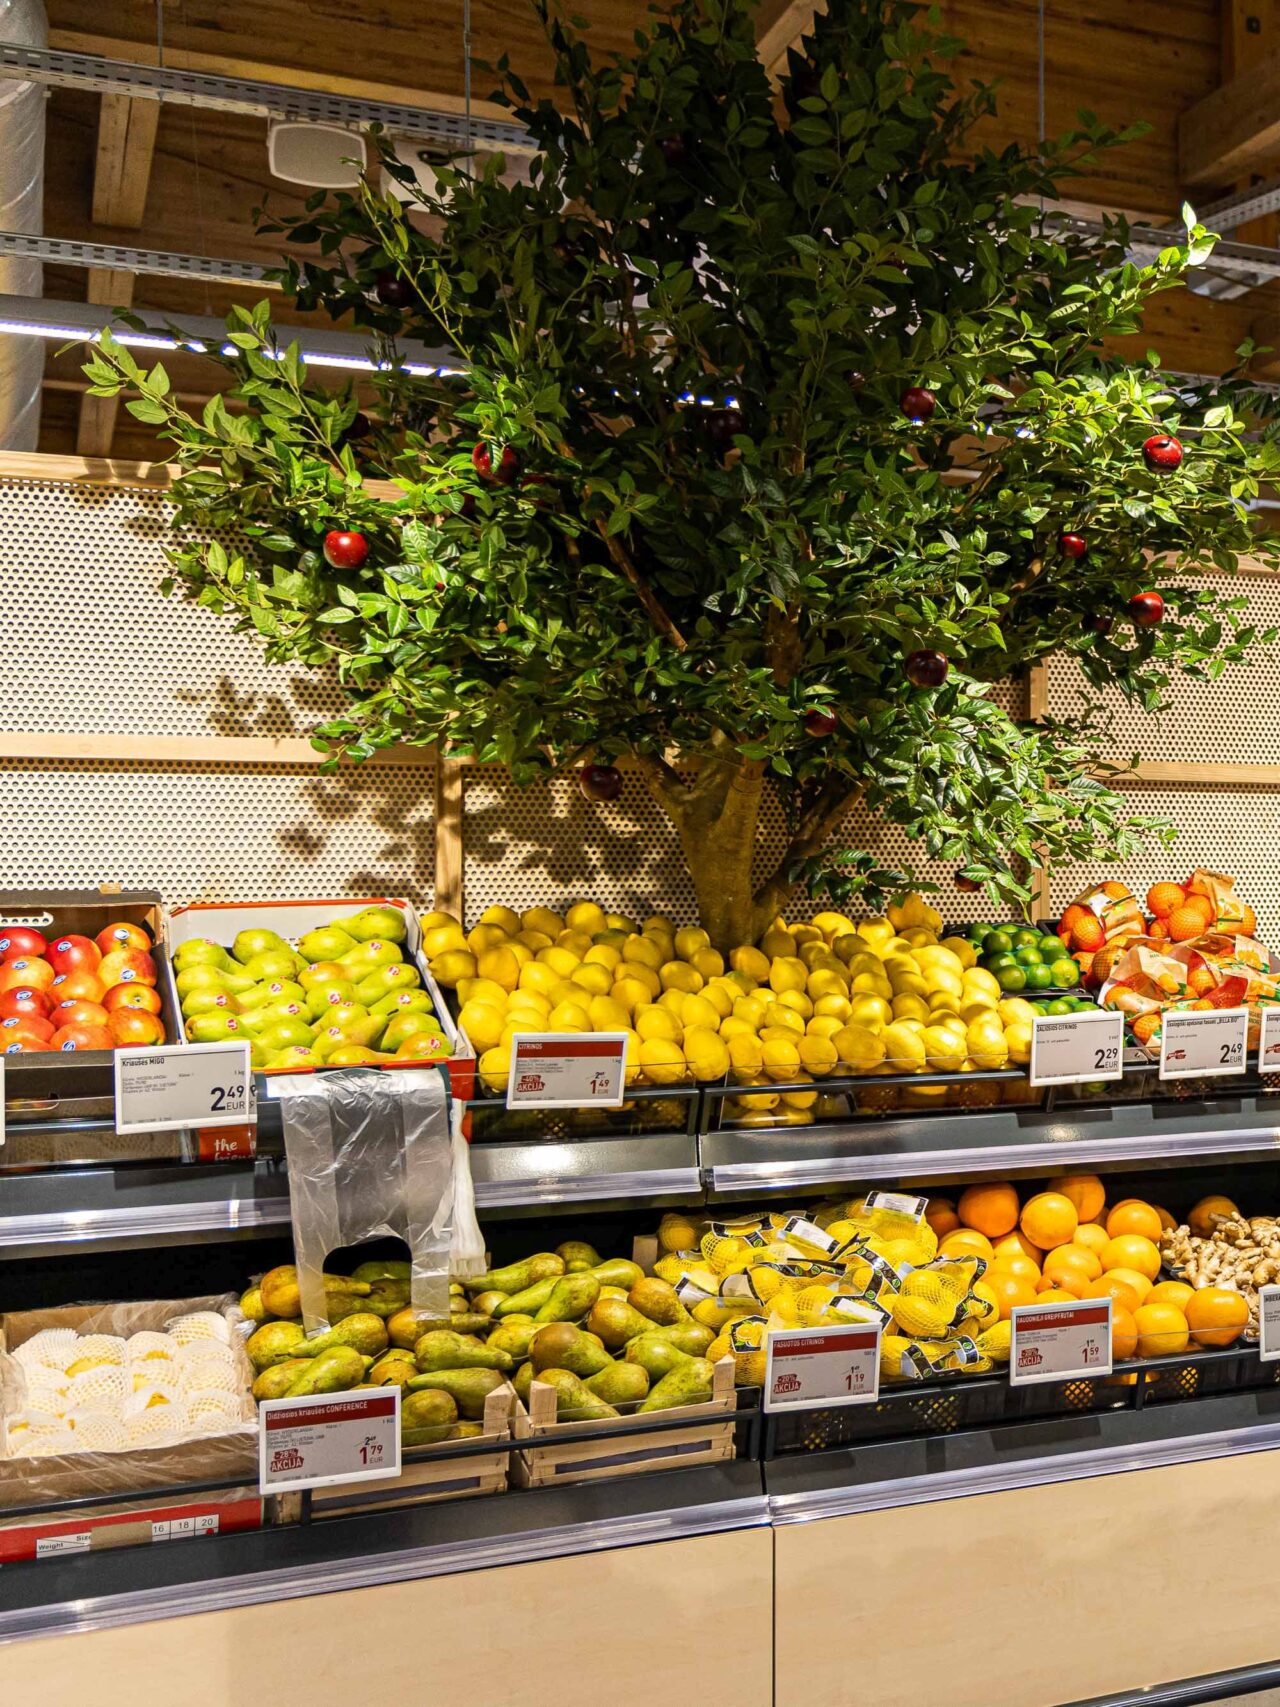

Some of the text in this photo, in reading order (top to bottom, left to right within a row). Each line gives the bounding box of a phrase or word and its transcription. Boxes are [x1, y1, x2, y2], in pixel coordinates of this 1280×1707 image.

[1105, 1060, 1119, 1069] EUR
[1229, 1055, 1243, 1064] EUR
[518, 1082, 544, 1092] AKCIJA
[226, 1100, 245, 1111] EUR
[214, 1138, 238, 1152] the
[801, 1337, 825, 1347] CITRINOS
[1018, 1355, 1042, 1367] AKCIJA
[774, 1381, 800, 1393] AKCIJA
[326, 1400, 368, 1412] CONFERENCE
[274, 1448, 298, 1459] -28%
[271, 1457, 302, 1472] AKCIJA
[178, 1521, 189, 1530] 18
[201, 1518, 214, 1527] 20
[153, 1524, 165, 1533] 16
[38, 1541, 64, 1551] Weight
